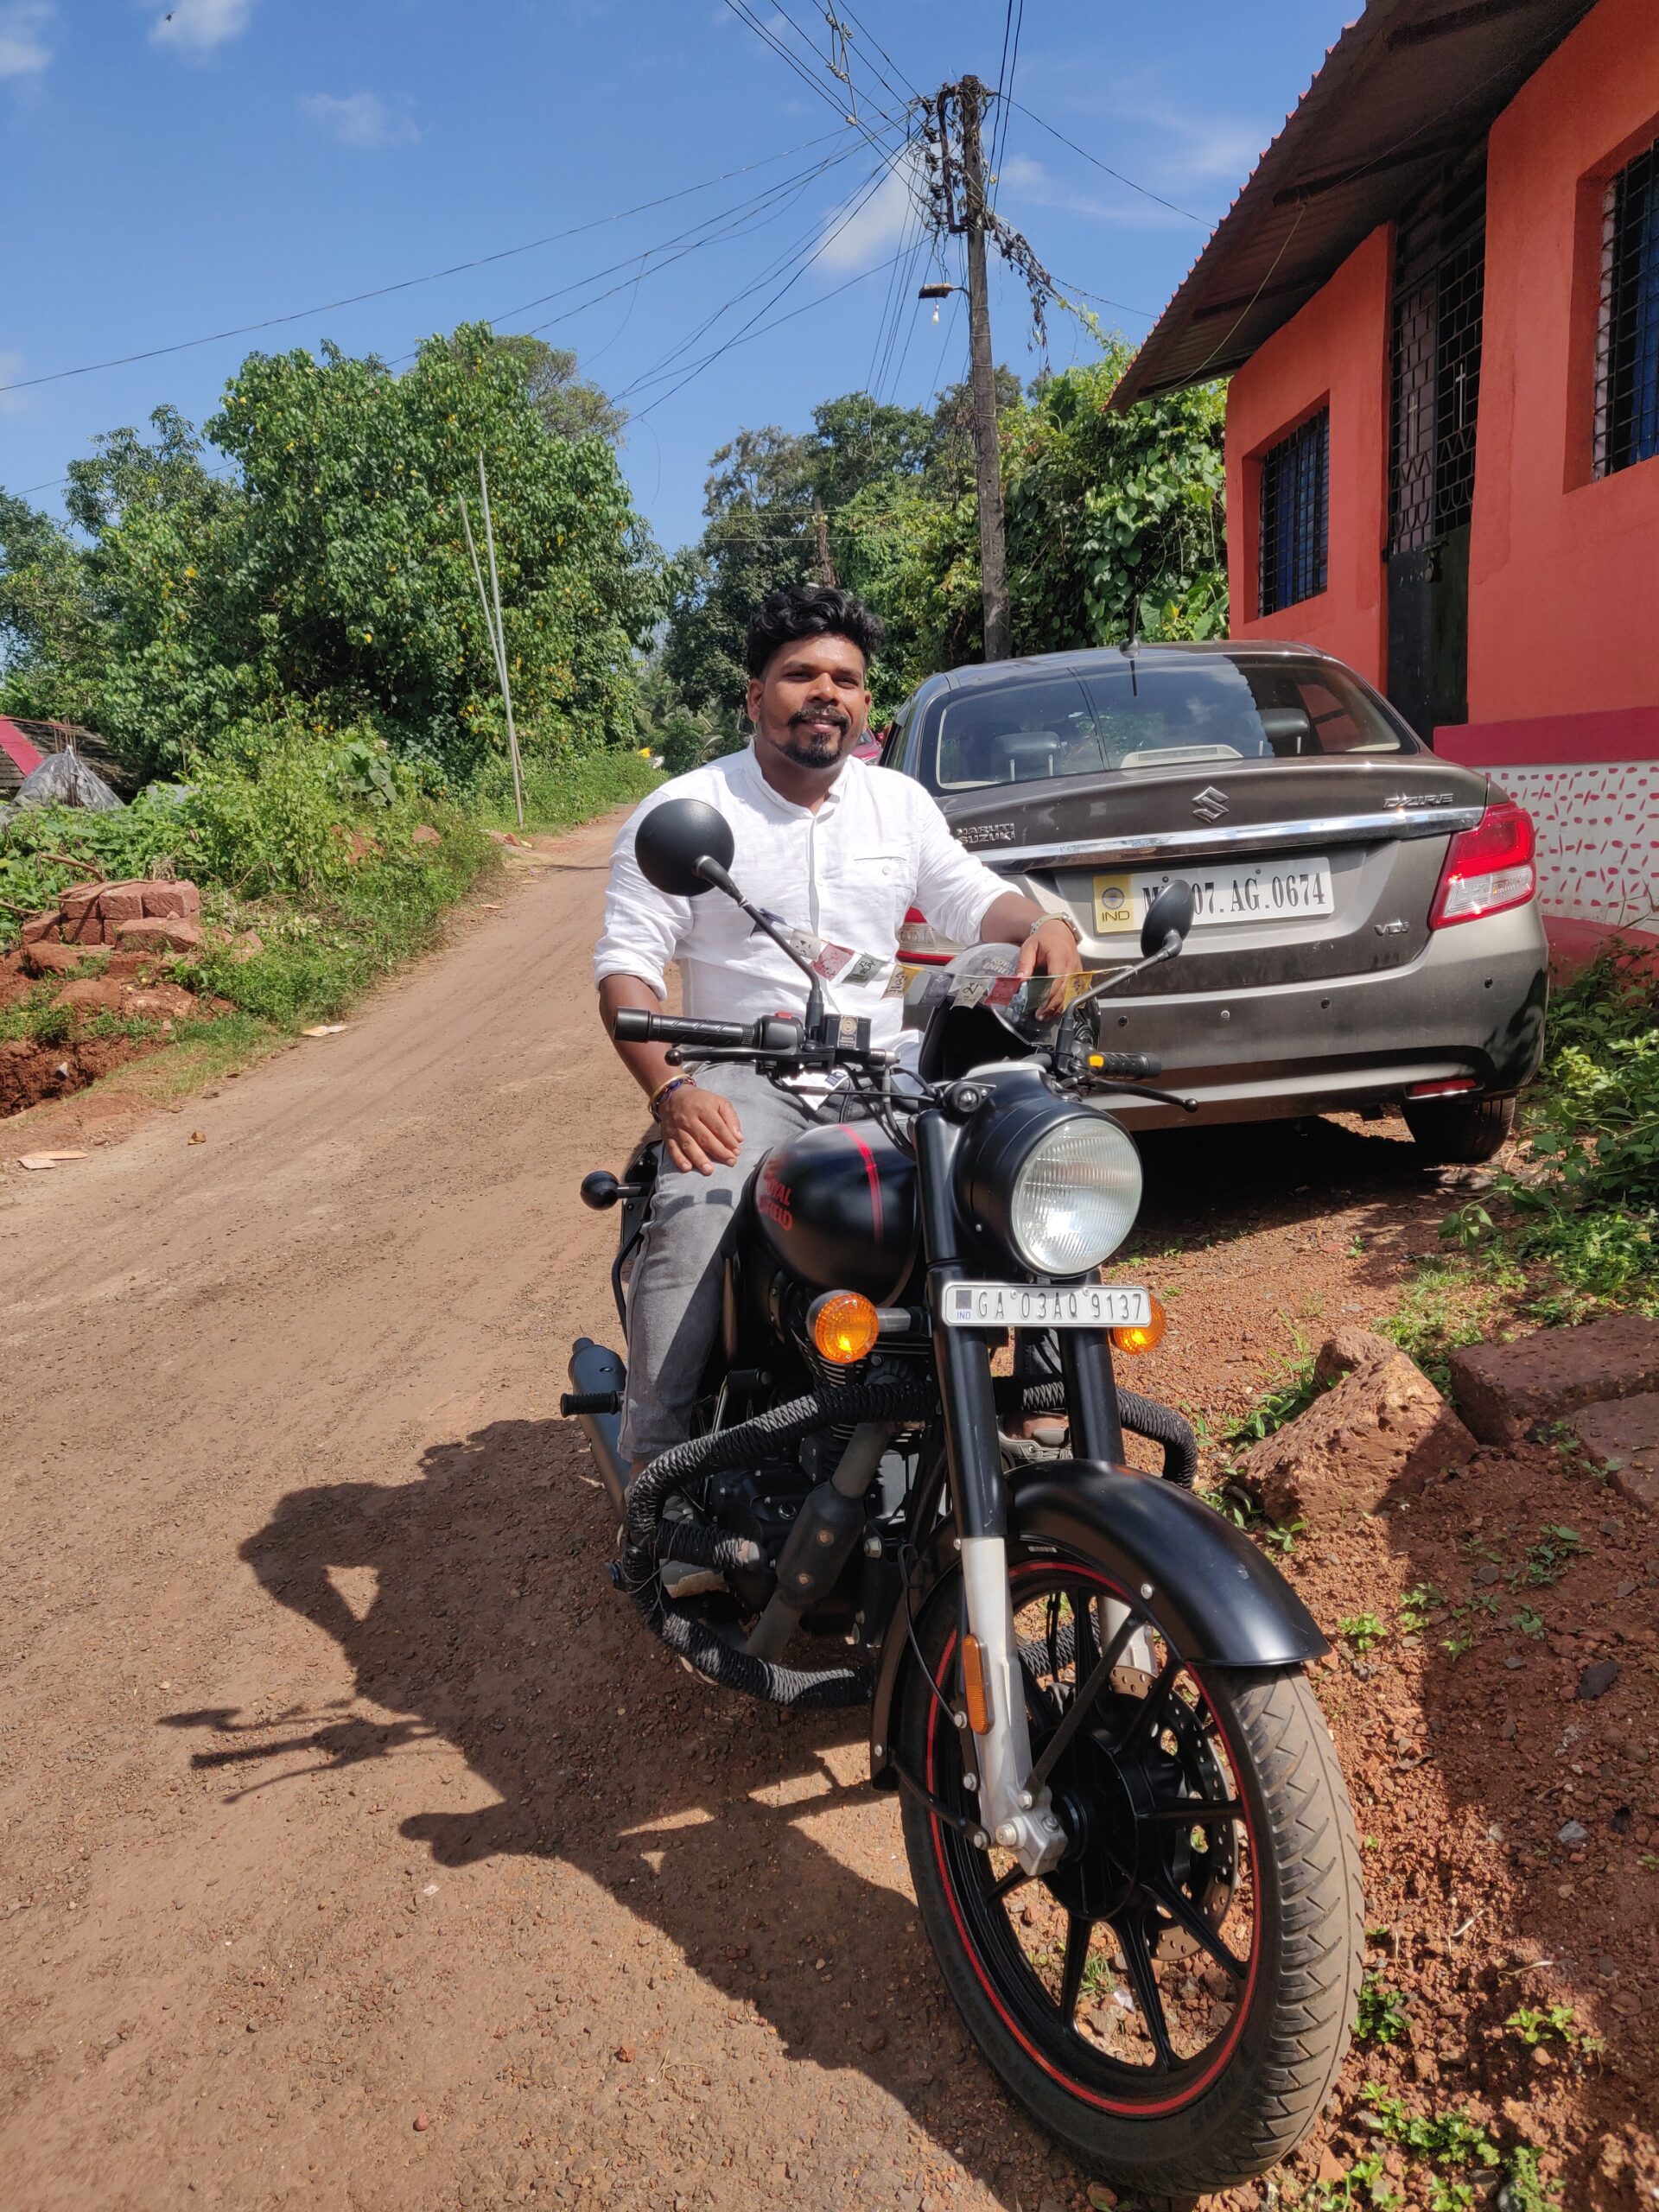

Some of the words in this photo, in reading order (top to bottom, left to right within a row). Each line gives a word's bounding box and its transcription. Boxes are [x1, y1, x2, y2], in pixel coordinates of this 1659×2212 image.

[1382, 792, 1454, 809] DZIRE
[957, 823, 1015, 836] MARUTI
[957, 830, 1016, 844] SUZUKI
[1102, 910, 1130, 923] IND
[982, 963, 1017, 976] ENFIEL
[957, 1311, 971, 1320] IND
[978, 1291, 1005, 1319] GA
[1020, 1292, 1077, 1320] 03AQ
[1090, 1293, 1142, 1319] 9137
